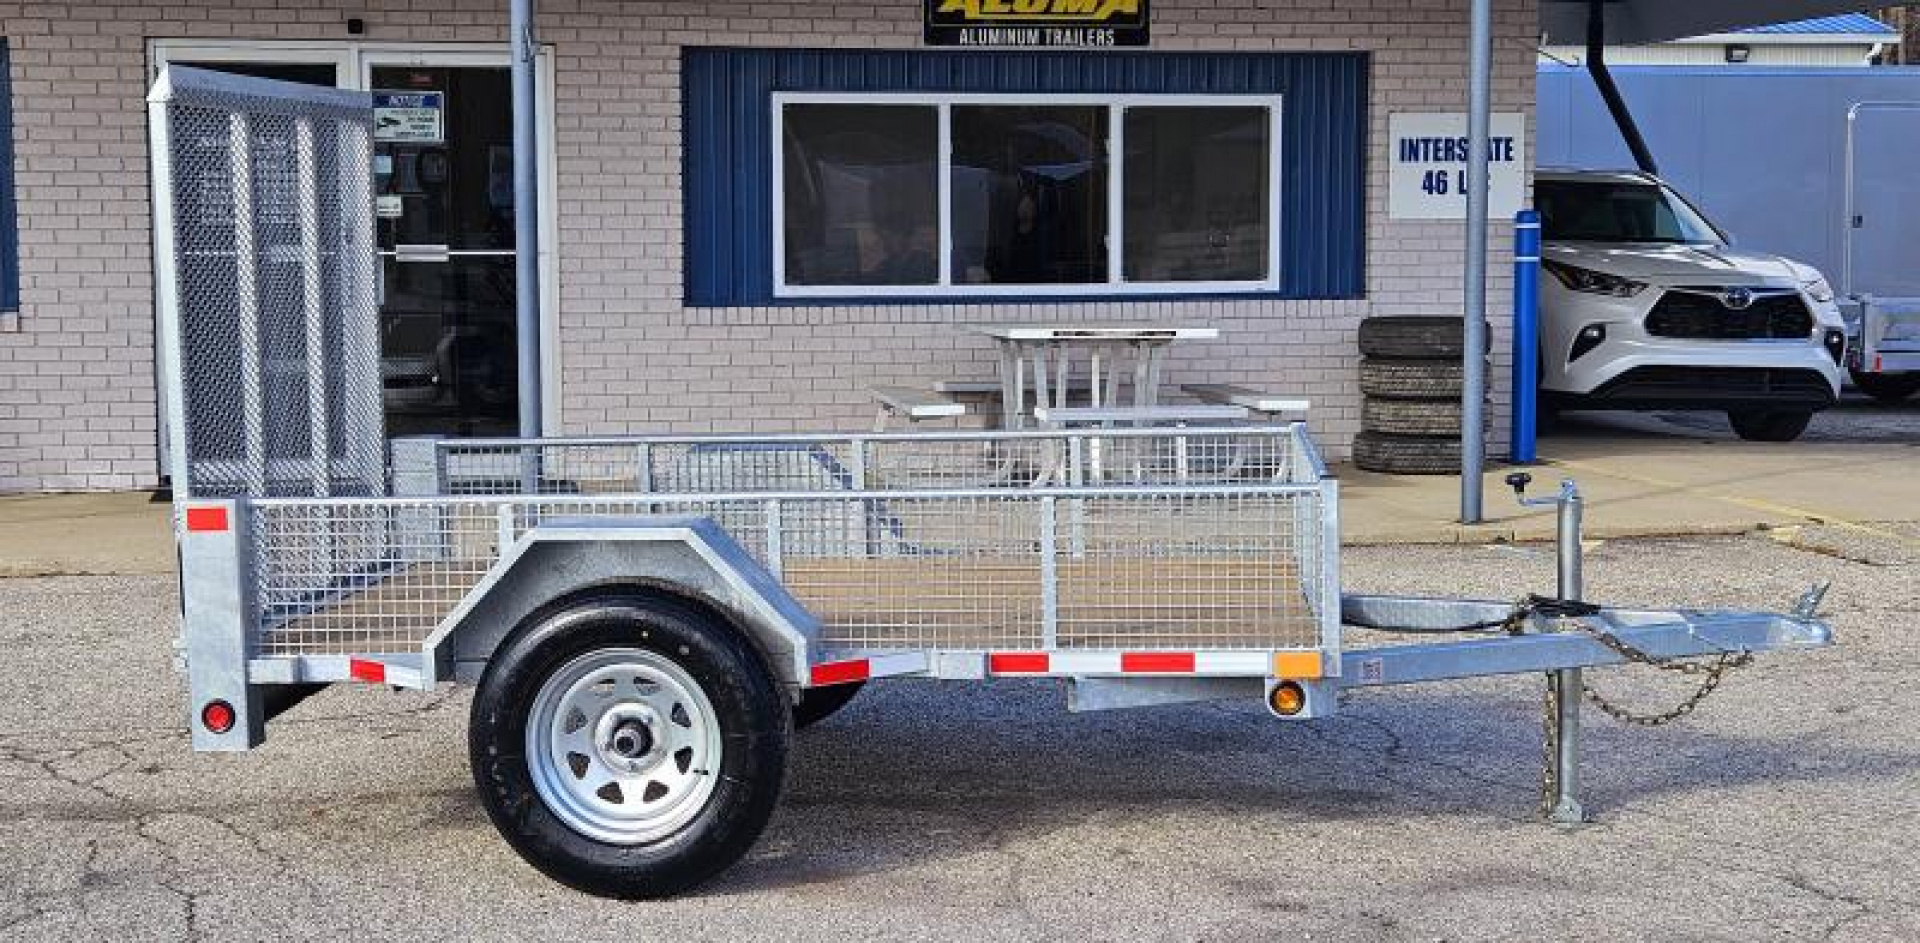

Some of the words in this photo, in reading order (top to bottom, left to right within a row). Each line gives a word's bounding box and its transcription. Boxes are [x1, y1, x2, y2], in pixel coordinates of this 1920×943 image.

[960, 28, 1039, 45] ALUMINUM
[1045, 28, 1114, 45] TRAILERS
[1400, 137, 1514, 161] INTERSTE
[1422, 170, 1447, 194] 46
